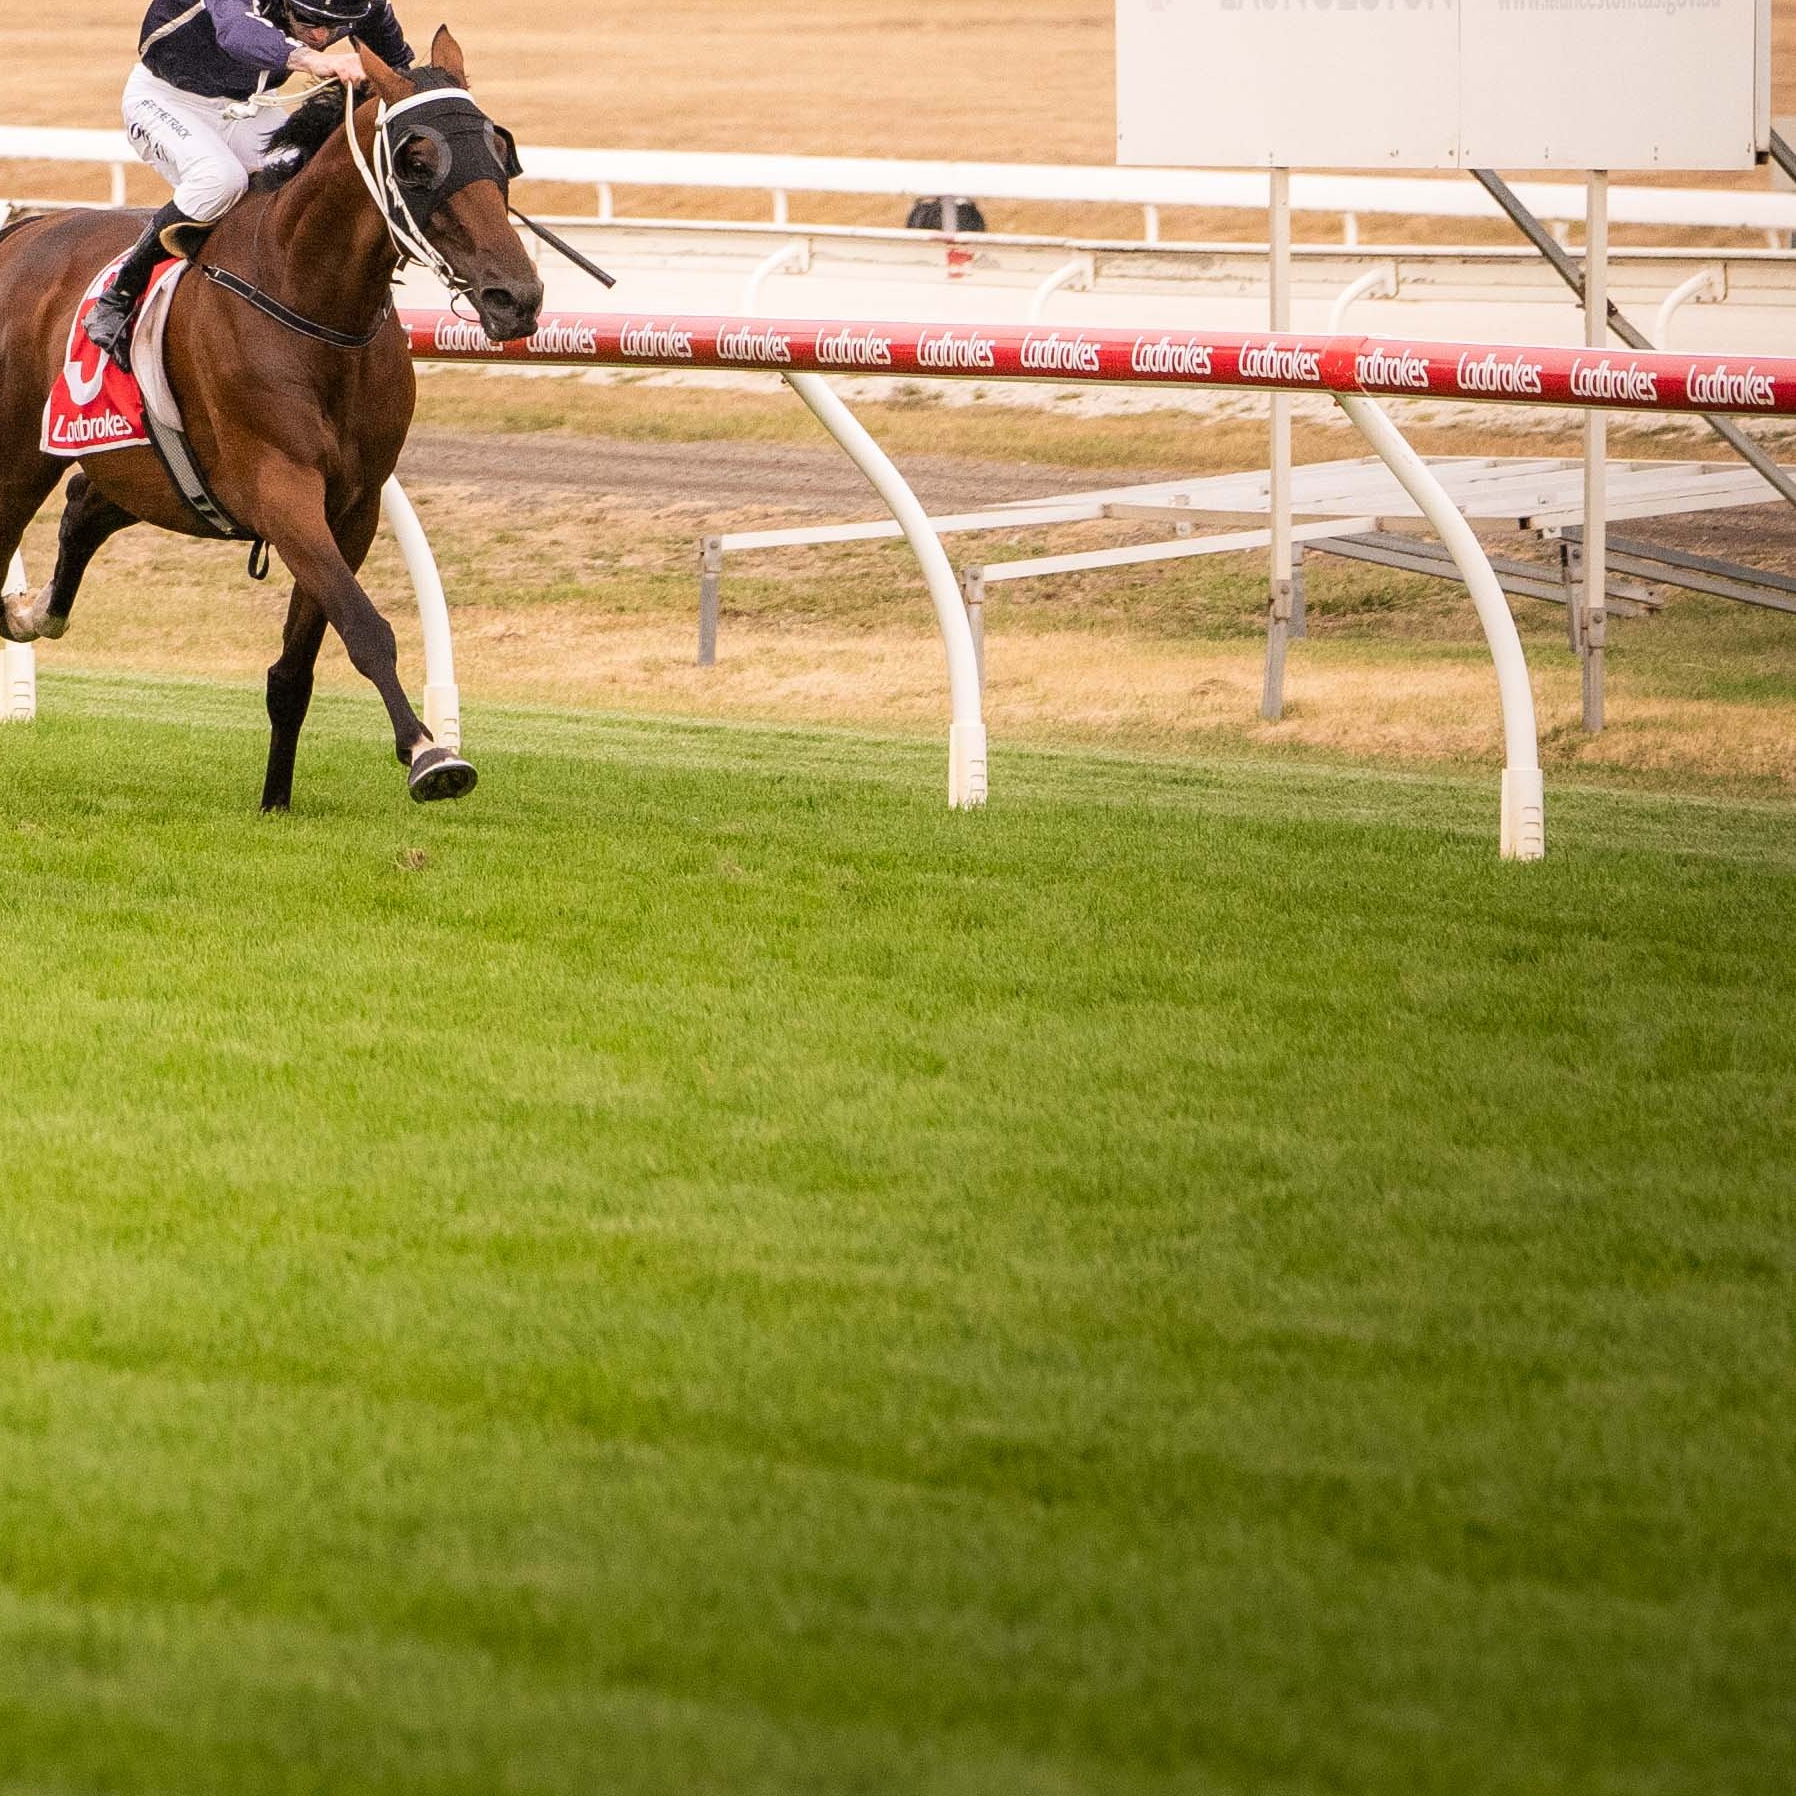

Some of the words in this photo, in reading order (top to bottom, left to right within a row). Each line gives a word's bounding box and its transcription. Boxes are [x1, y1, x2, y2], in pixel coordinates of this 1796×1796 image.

[620, 321, 692, 359] Ladbrokes
[716, 324, 792, 362] Ladbrokes
[815, 328, 892, 365] Ladbrokes
[916, 330, 996, 368] Ladbrokes
[1020, 332, 1101, 372] Ladbrokes
[1131, 336, 1212, 375] Ladbrokes
[1239, 339, 1320, 381] Ladbrokes
[1354, 347, 1429, 388] adbrokes
[1457, 351, 1542, 394] Ladbrokes
[1570, 357, 1657, 402] Ladbrokes
[1686, 363, 1776, 406] Ladbrokes
[52, 409, 133, 443] Ladbrokes
